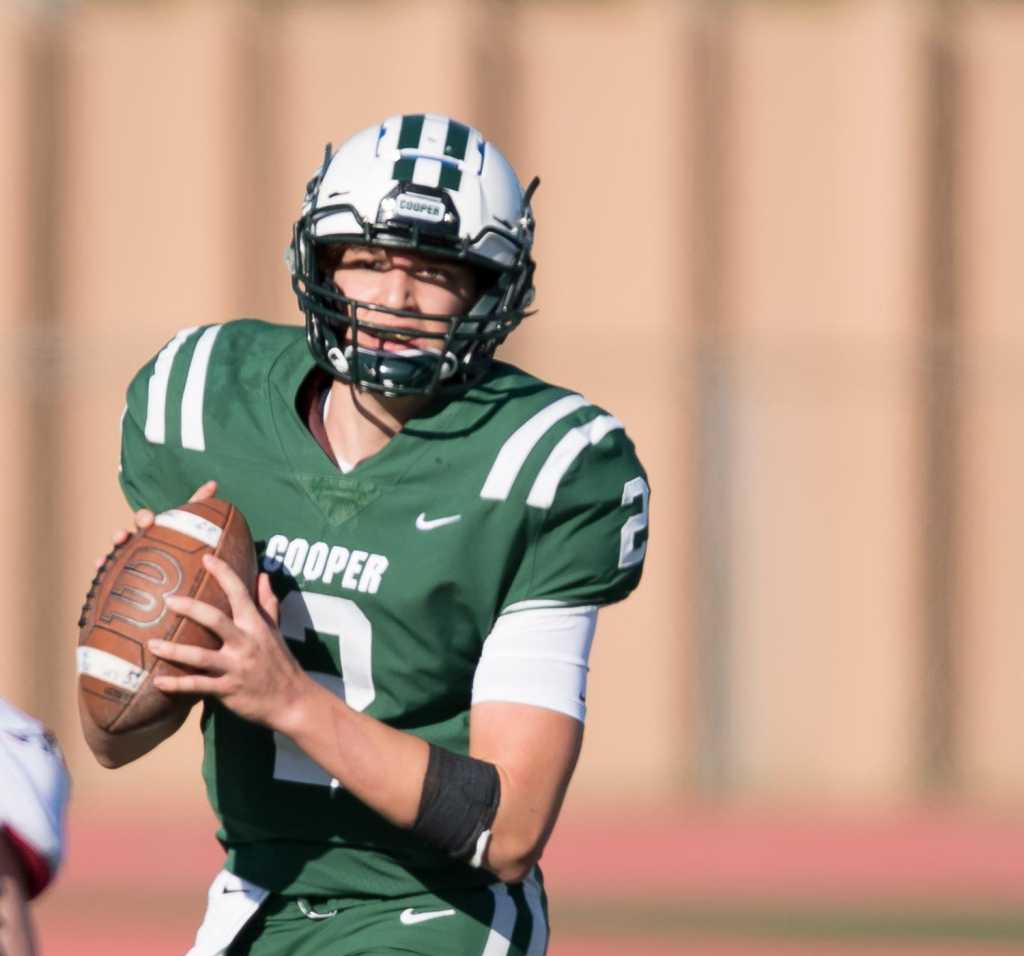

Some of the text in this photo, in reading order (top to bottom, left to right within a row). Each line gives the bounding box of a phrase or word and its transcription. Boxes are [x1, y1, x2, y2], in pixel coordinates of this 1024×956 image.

[399, 200, 440, 216] COOPER
[619, 475, 650, 569] 2
[264, 534, 389, 594] COOPER
